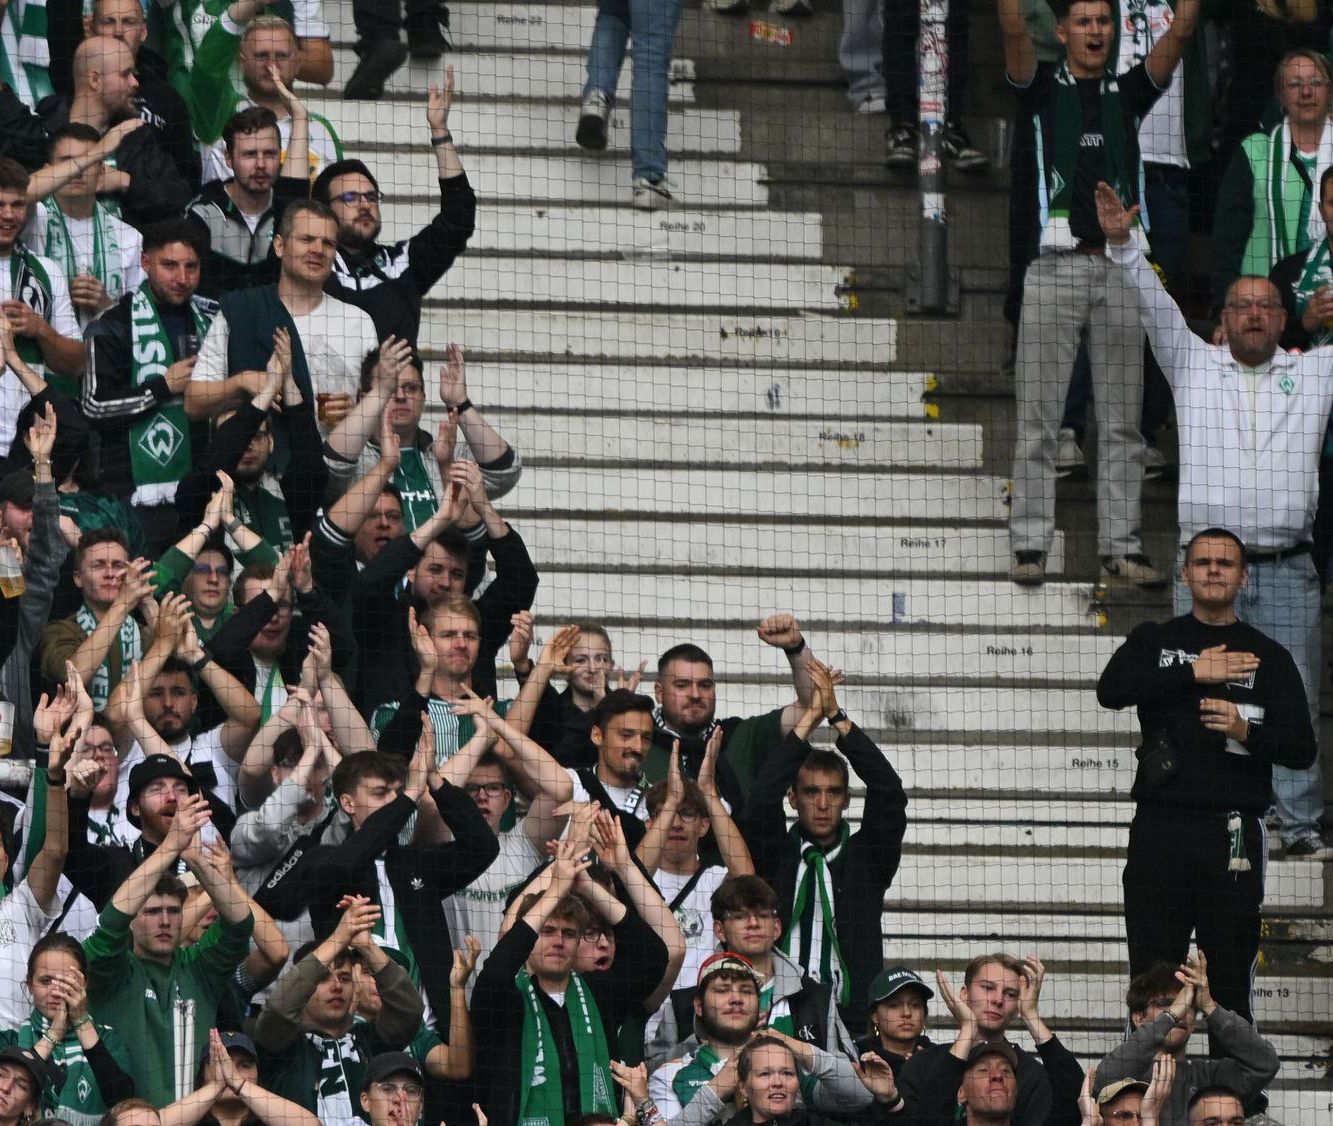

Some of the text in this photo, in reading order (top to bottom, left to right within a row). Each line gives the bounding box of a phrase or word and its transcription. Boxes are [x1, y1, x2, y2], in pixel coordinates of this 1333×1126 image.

[660, 221, 689, 231] Reihe
[901, 539, 930, 548] Reihe
[987, 646, 1033, 656] Reihe 16
[1072, 758, 1119, 768] Reihe 15
[267, 849, 303, 888] adidas
[1278, 988, 1290, 998] 13
